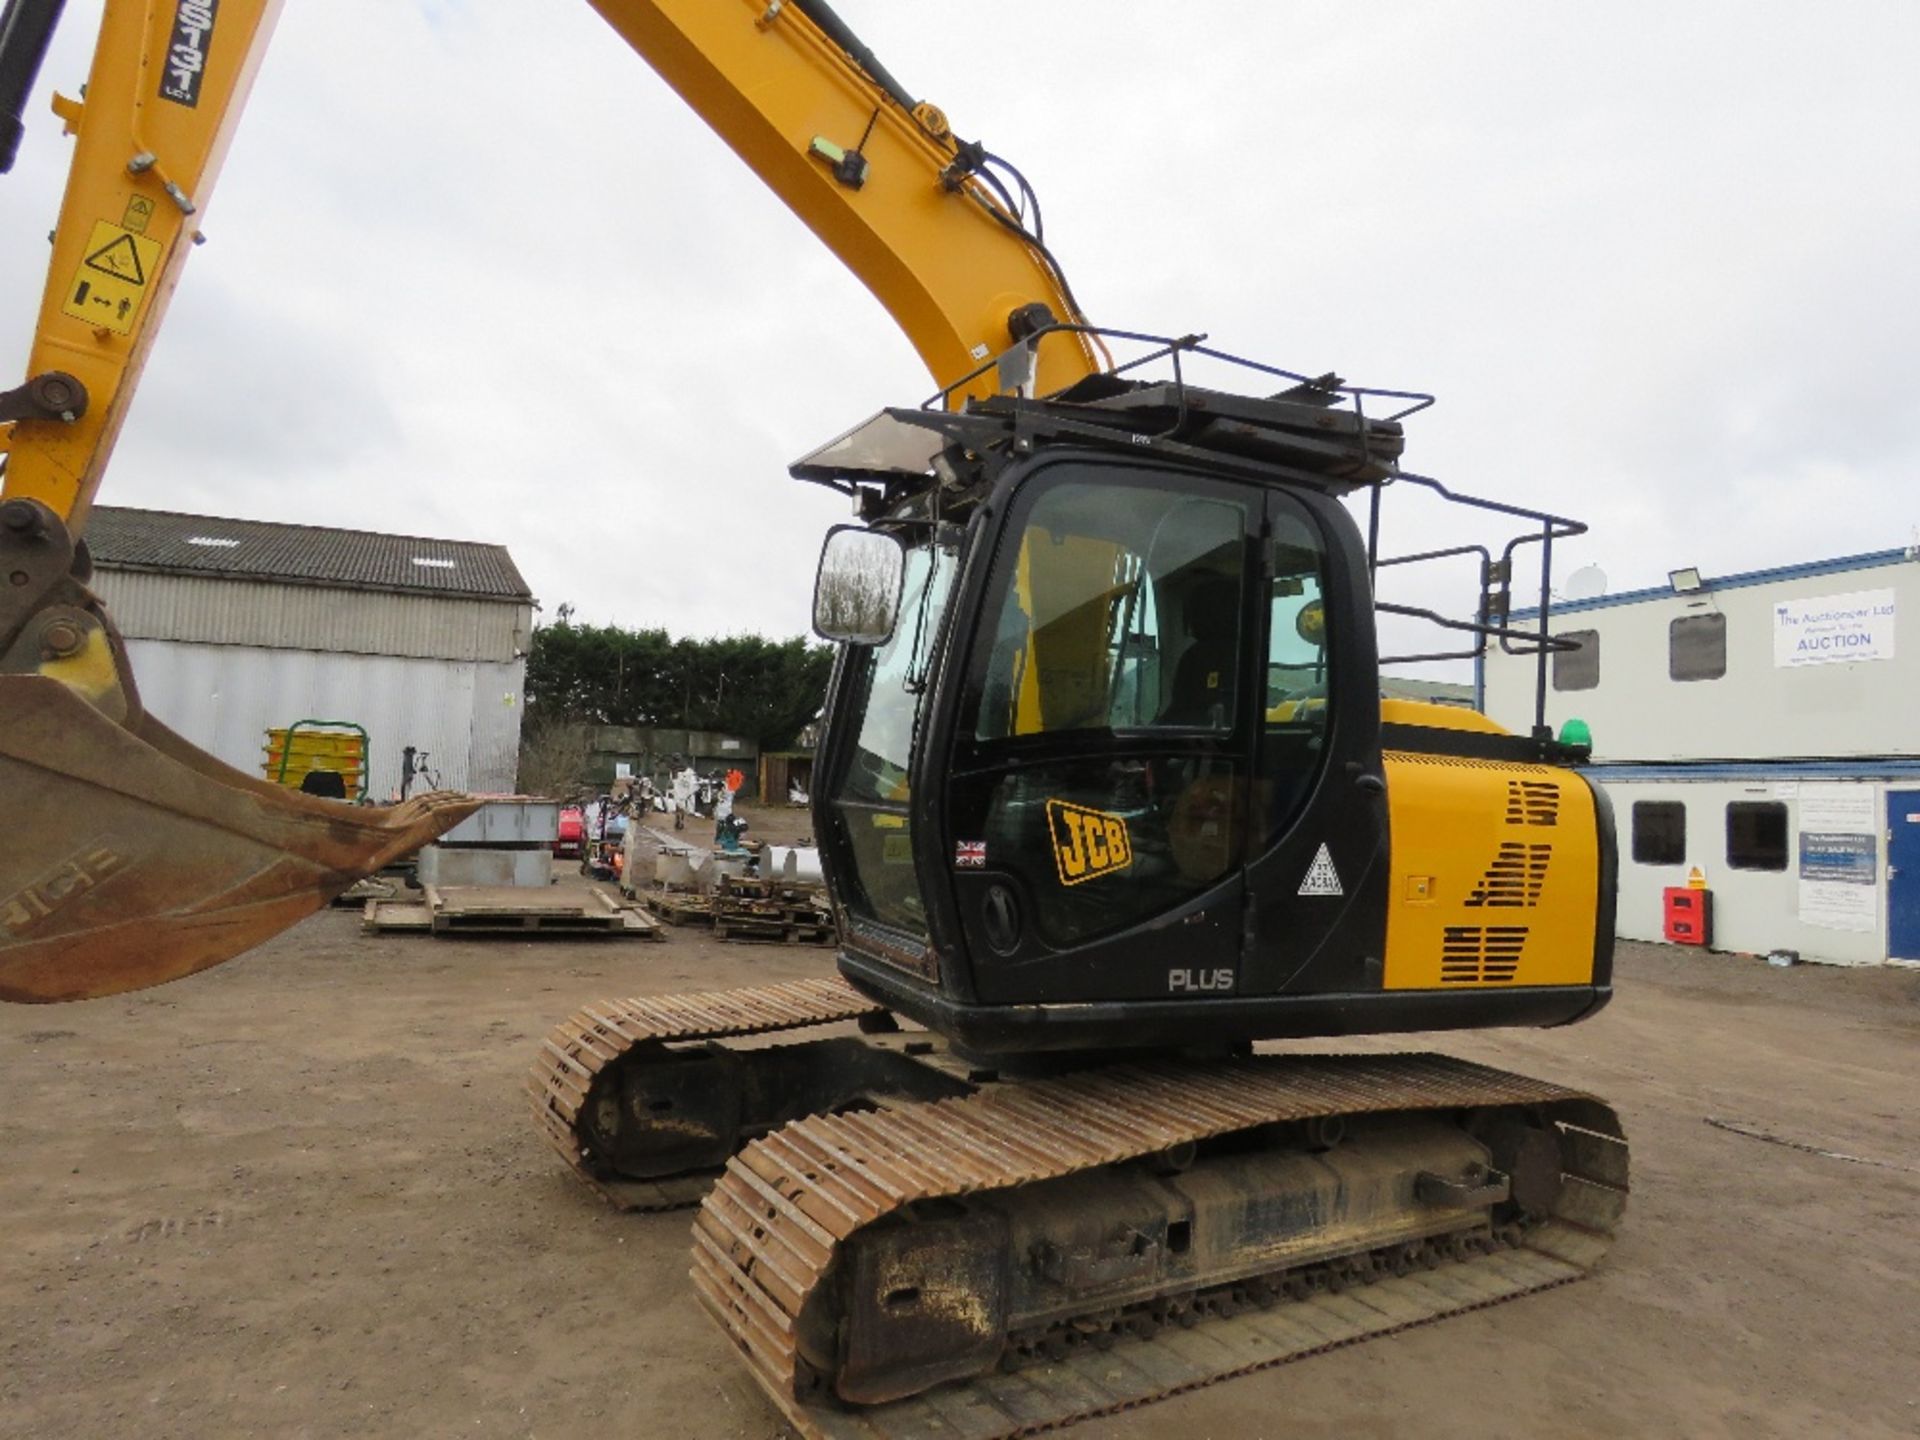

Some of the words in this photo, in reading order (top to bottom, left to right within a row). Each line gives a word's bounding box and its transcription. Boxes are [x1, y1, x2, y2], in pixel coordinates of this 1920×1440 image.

[170, 0, 212, 91] S131
[1779, 611, 1799, 626] The
[1803, 609, 1868, 623] Auctioneer
[1873, 604, 1894, 616] Ltd
[1797, 633, 1872, 651] AUCTION
[1060, 809, 1127, 877] JCB
[1168, 969, 1234, 991] PLUS
